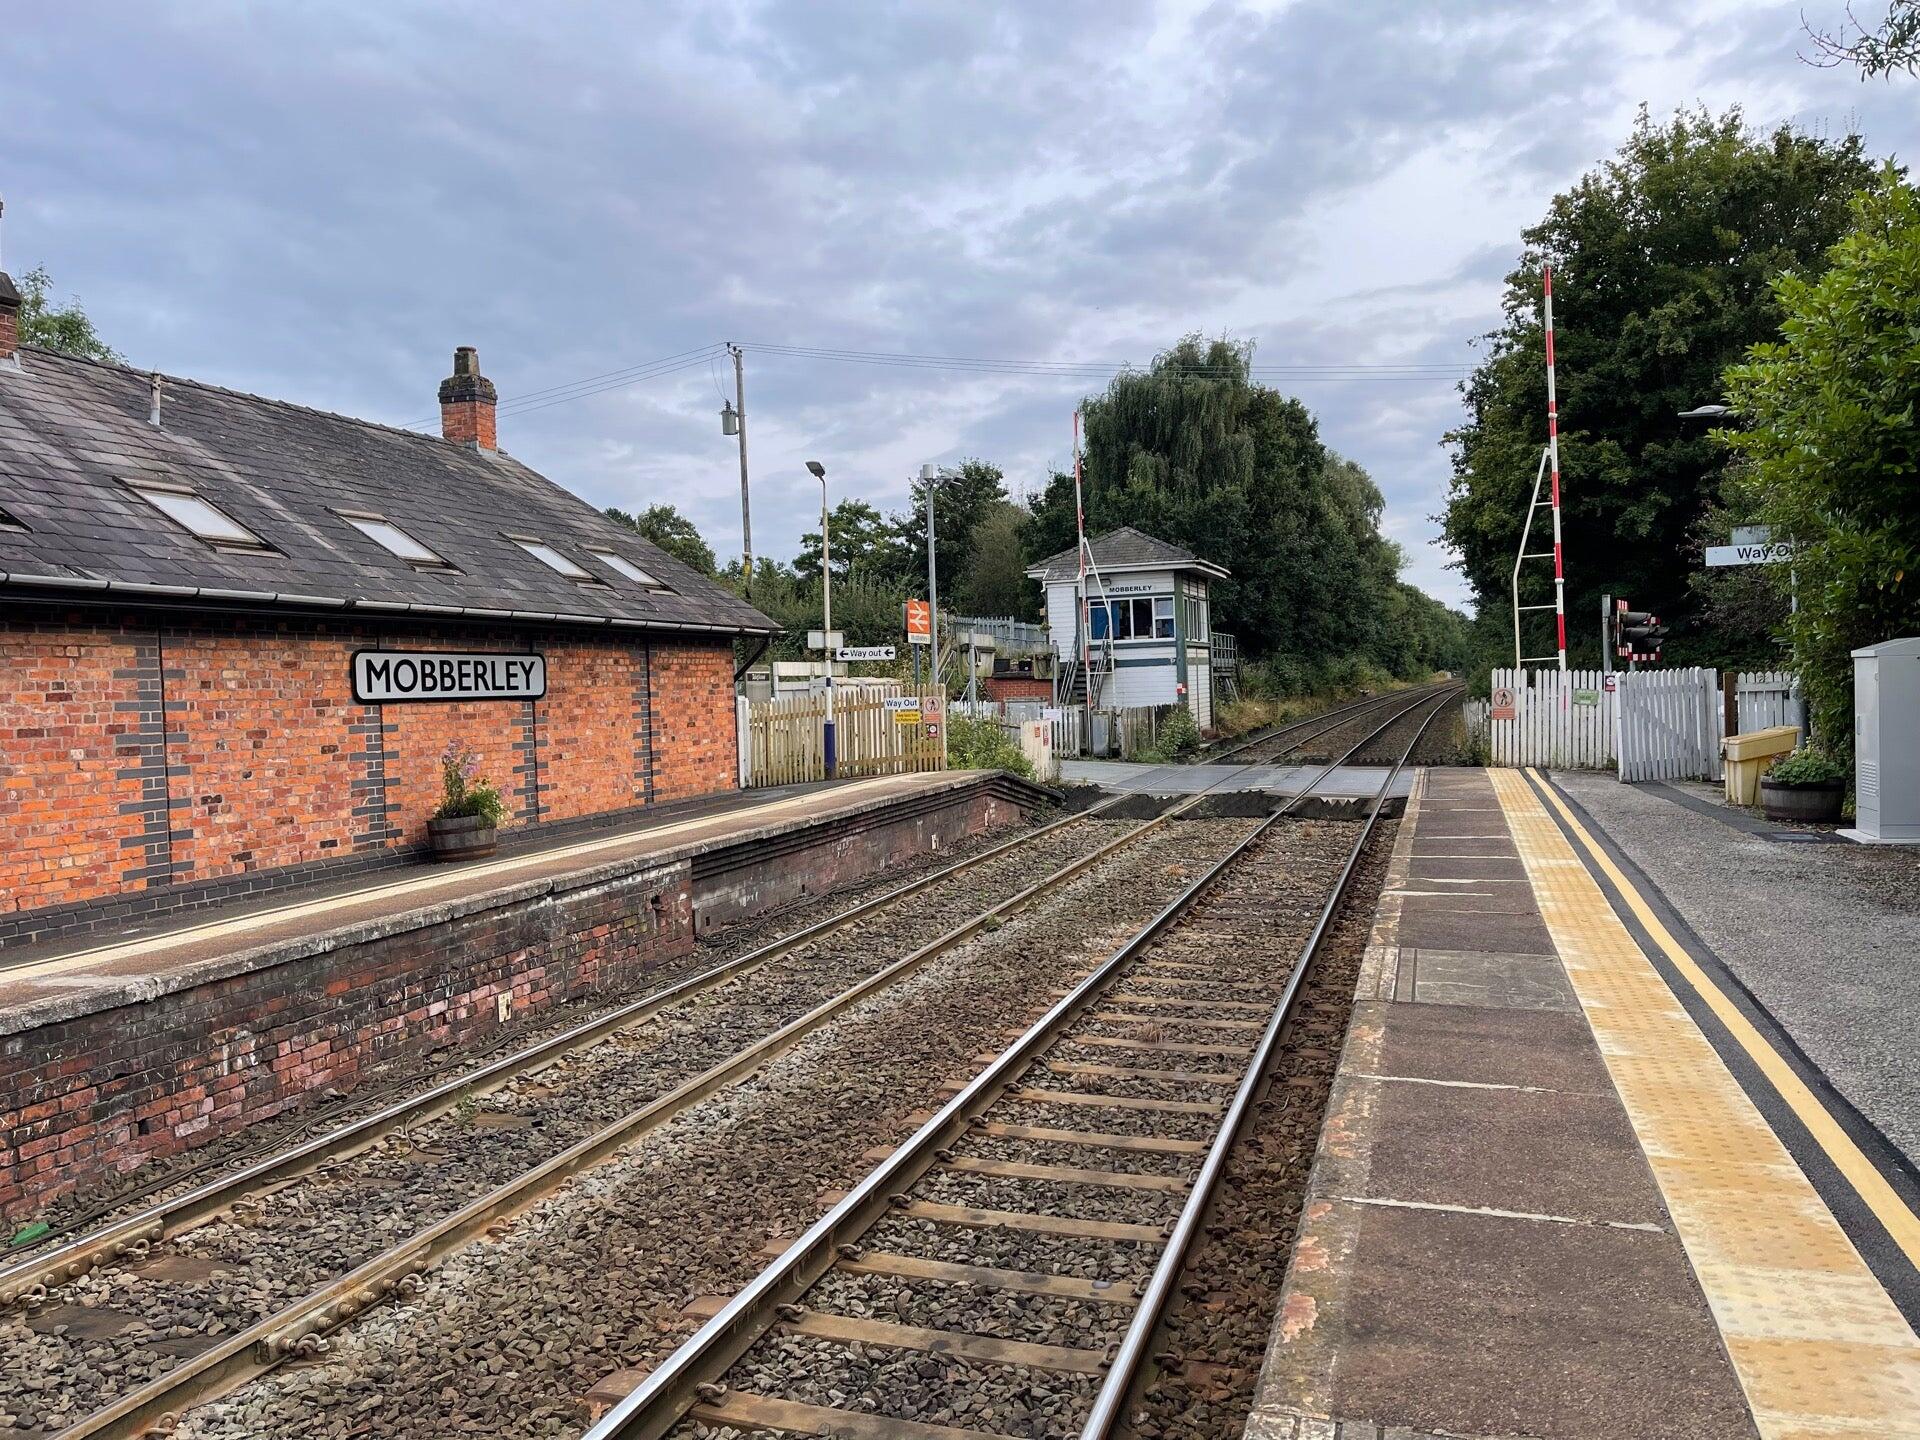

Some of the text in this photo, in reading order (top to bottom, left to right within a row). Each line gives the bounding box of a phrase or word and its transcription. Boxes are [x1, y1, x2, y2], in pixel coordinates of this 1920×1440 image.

[1737, 547, 1770, 561] Way
[1109, 585, 1152, 593] MOBBERLEY
[850, 648, 881, 658] Way out
[365, 658, 536, 693] MOBBERLEY
[886, 699, 917, 708] Way Out
